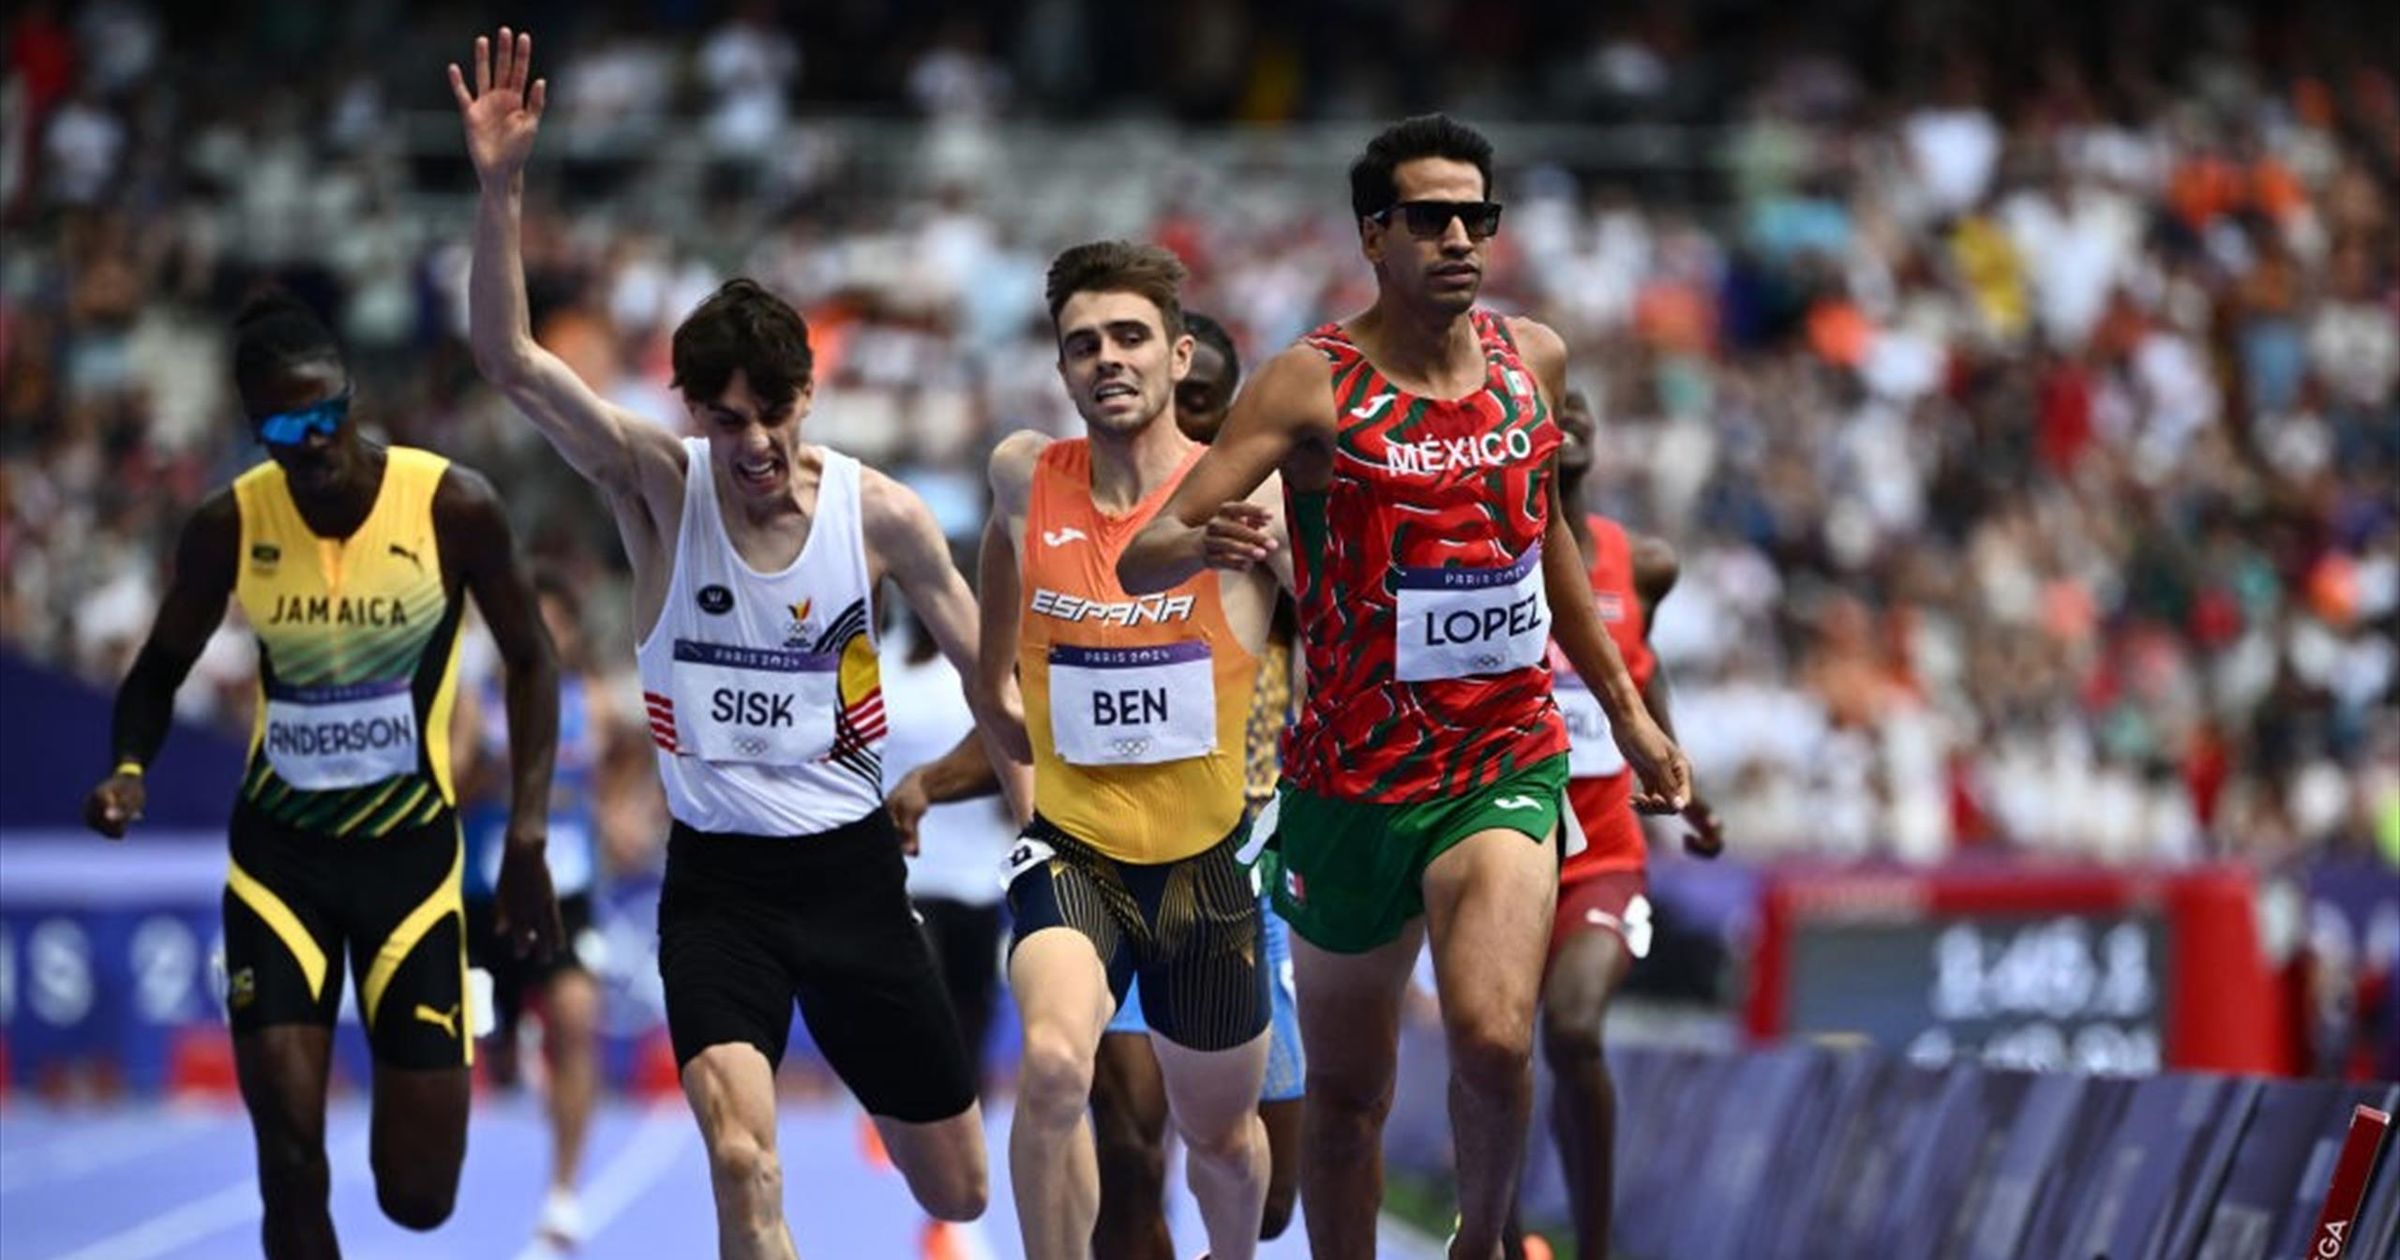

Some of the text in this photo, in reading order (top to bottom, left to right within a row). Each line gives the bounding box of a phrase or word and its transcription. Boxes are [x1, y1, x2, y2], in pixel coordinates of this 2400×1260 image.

[1386, 428, 1531, 477] MÉXICO
[1445, 573, 1490, 585] PARIS
[269, 595, 407, 625] JAMAICA
[1031, 588, 1196, 627] ESPAÑA
[1425, 592, 1542, 646] LOPEZ
[714, 650, 800, 668] PARIS 2024
[1084, 652, 1170, 664] PARIS 2024
[711, 688, 795, 728] SISK
[1093, 687, 1168, 727] BEN
[269, 715, 412, 756] ANDERSON
